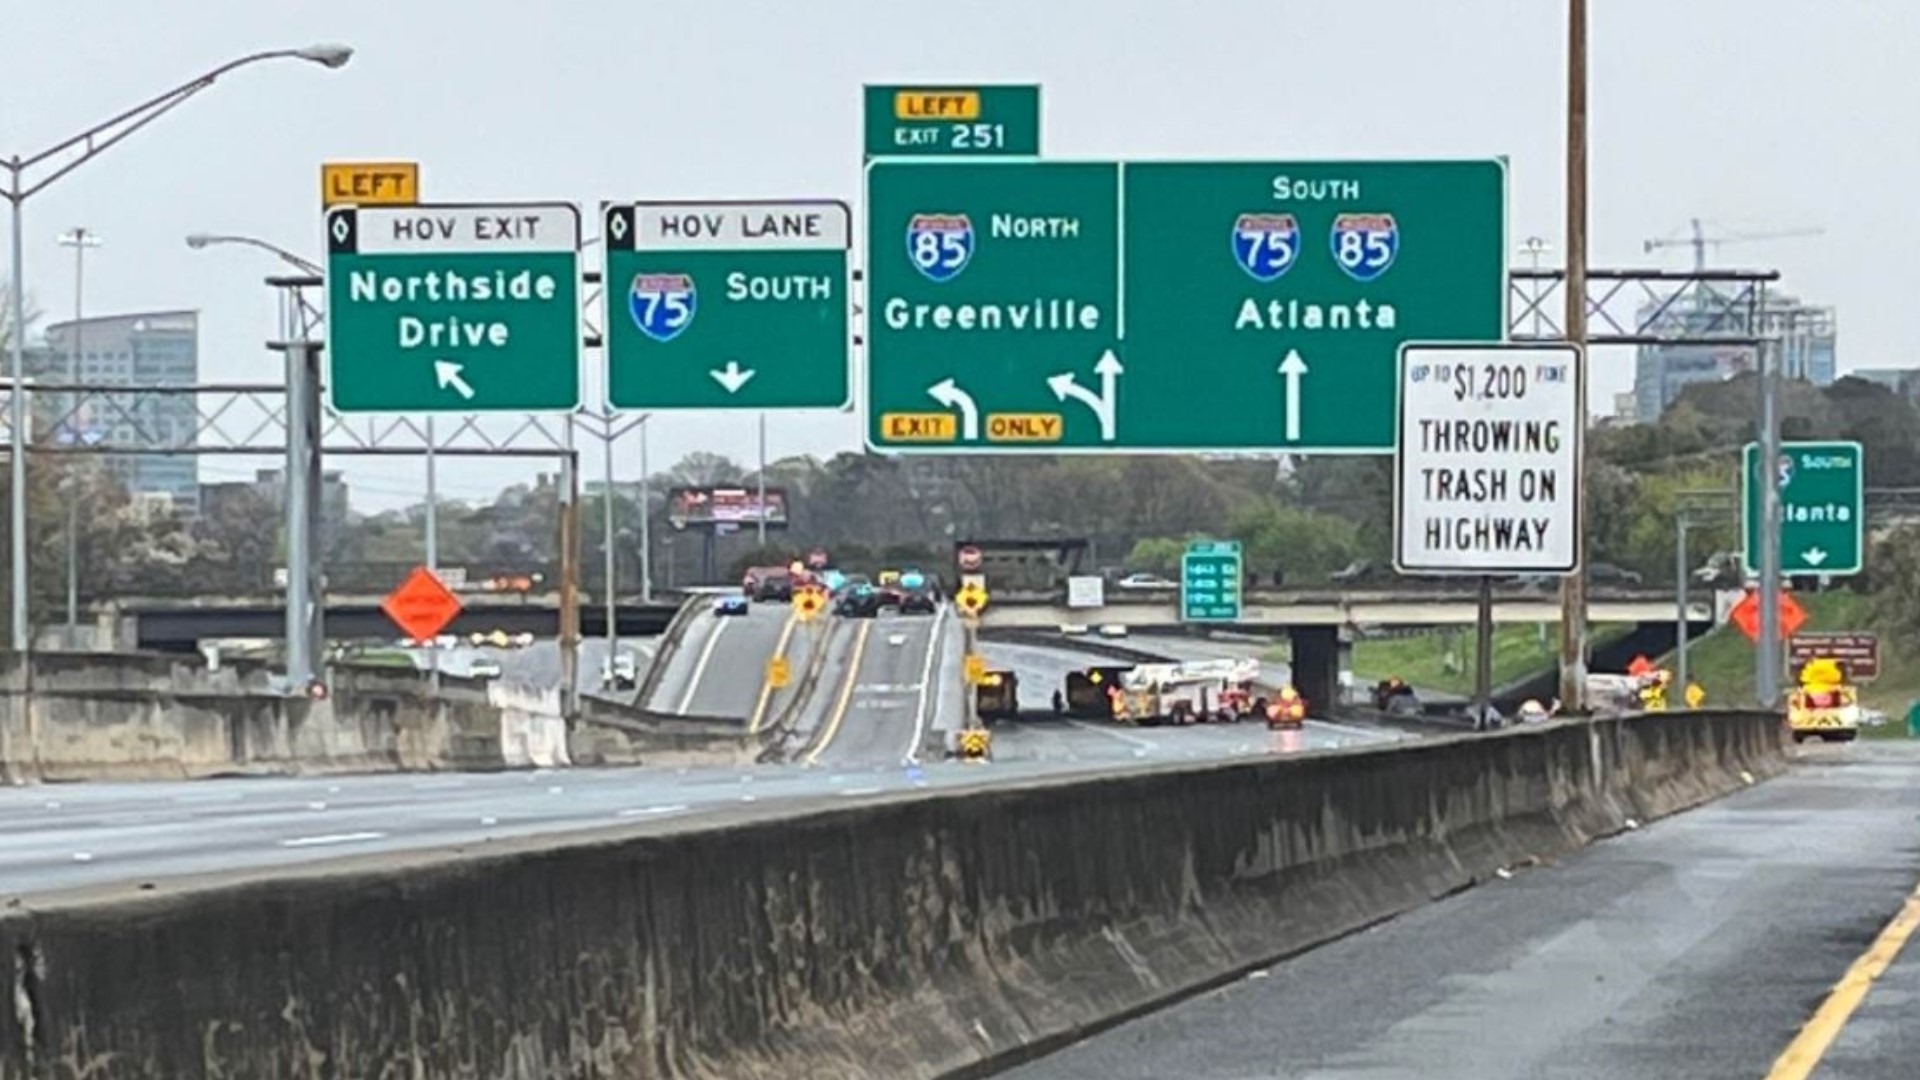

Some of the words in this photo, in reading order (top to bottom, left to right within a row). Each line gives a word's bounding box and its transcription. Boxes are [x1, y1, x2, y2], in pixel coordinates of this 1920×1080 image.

[905, 95, 967, 116] LEFT
[895, 128, 938, 147] EXIT
[951, 125, 1005, 148] 251
[333, 174, 408, 198] LEFT
[1272, 175, 1359, 201] SOUTH
[393, 218, 456, 240] HOV
[476, 217, 541, 240] EXIT
[660, 215, 725, 237] HOV
[742, 215, 821, 237] LANE
[915, 231, 966, 268] 85
[992, 214, 1079, 239] NORTH
[1241, 230, 1293, 267] 75
[1338, 230, 1392, 267] 85
[350, 270, 557, 302] Northside
[642, 293, 689, 327] 75
[726, 273, 831, 300] SOUTH
[884, 297, 1100, 331] Greenville
[1235, 298, 1397, 331] Atlanta
[399, 316, 509, 347] Drive
[890, 418, 943, 438] EXIT
[990, 417, 1057, 438] ONLY
[1419, 420, 1561, 454] THROWING
[1421, 469, 1507, 502] TRASH
[1520, 469, 1556, 502] ON
[1425, 517, 1550, 551] HIGHWAY
